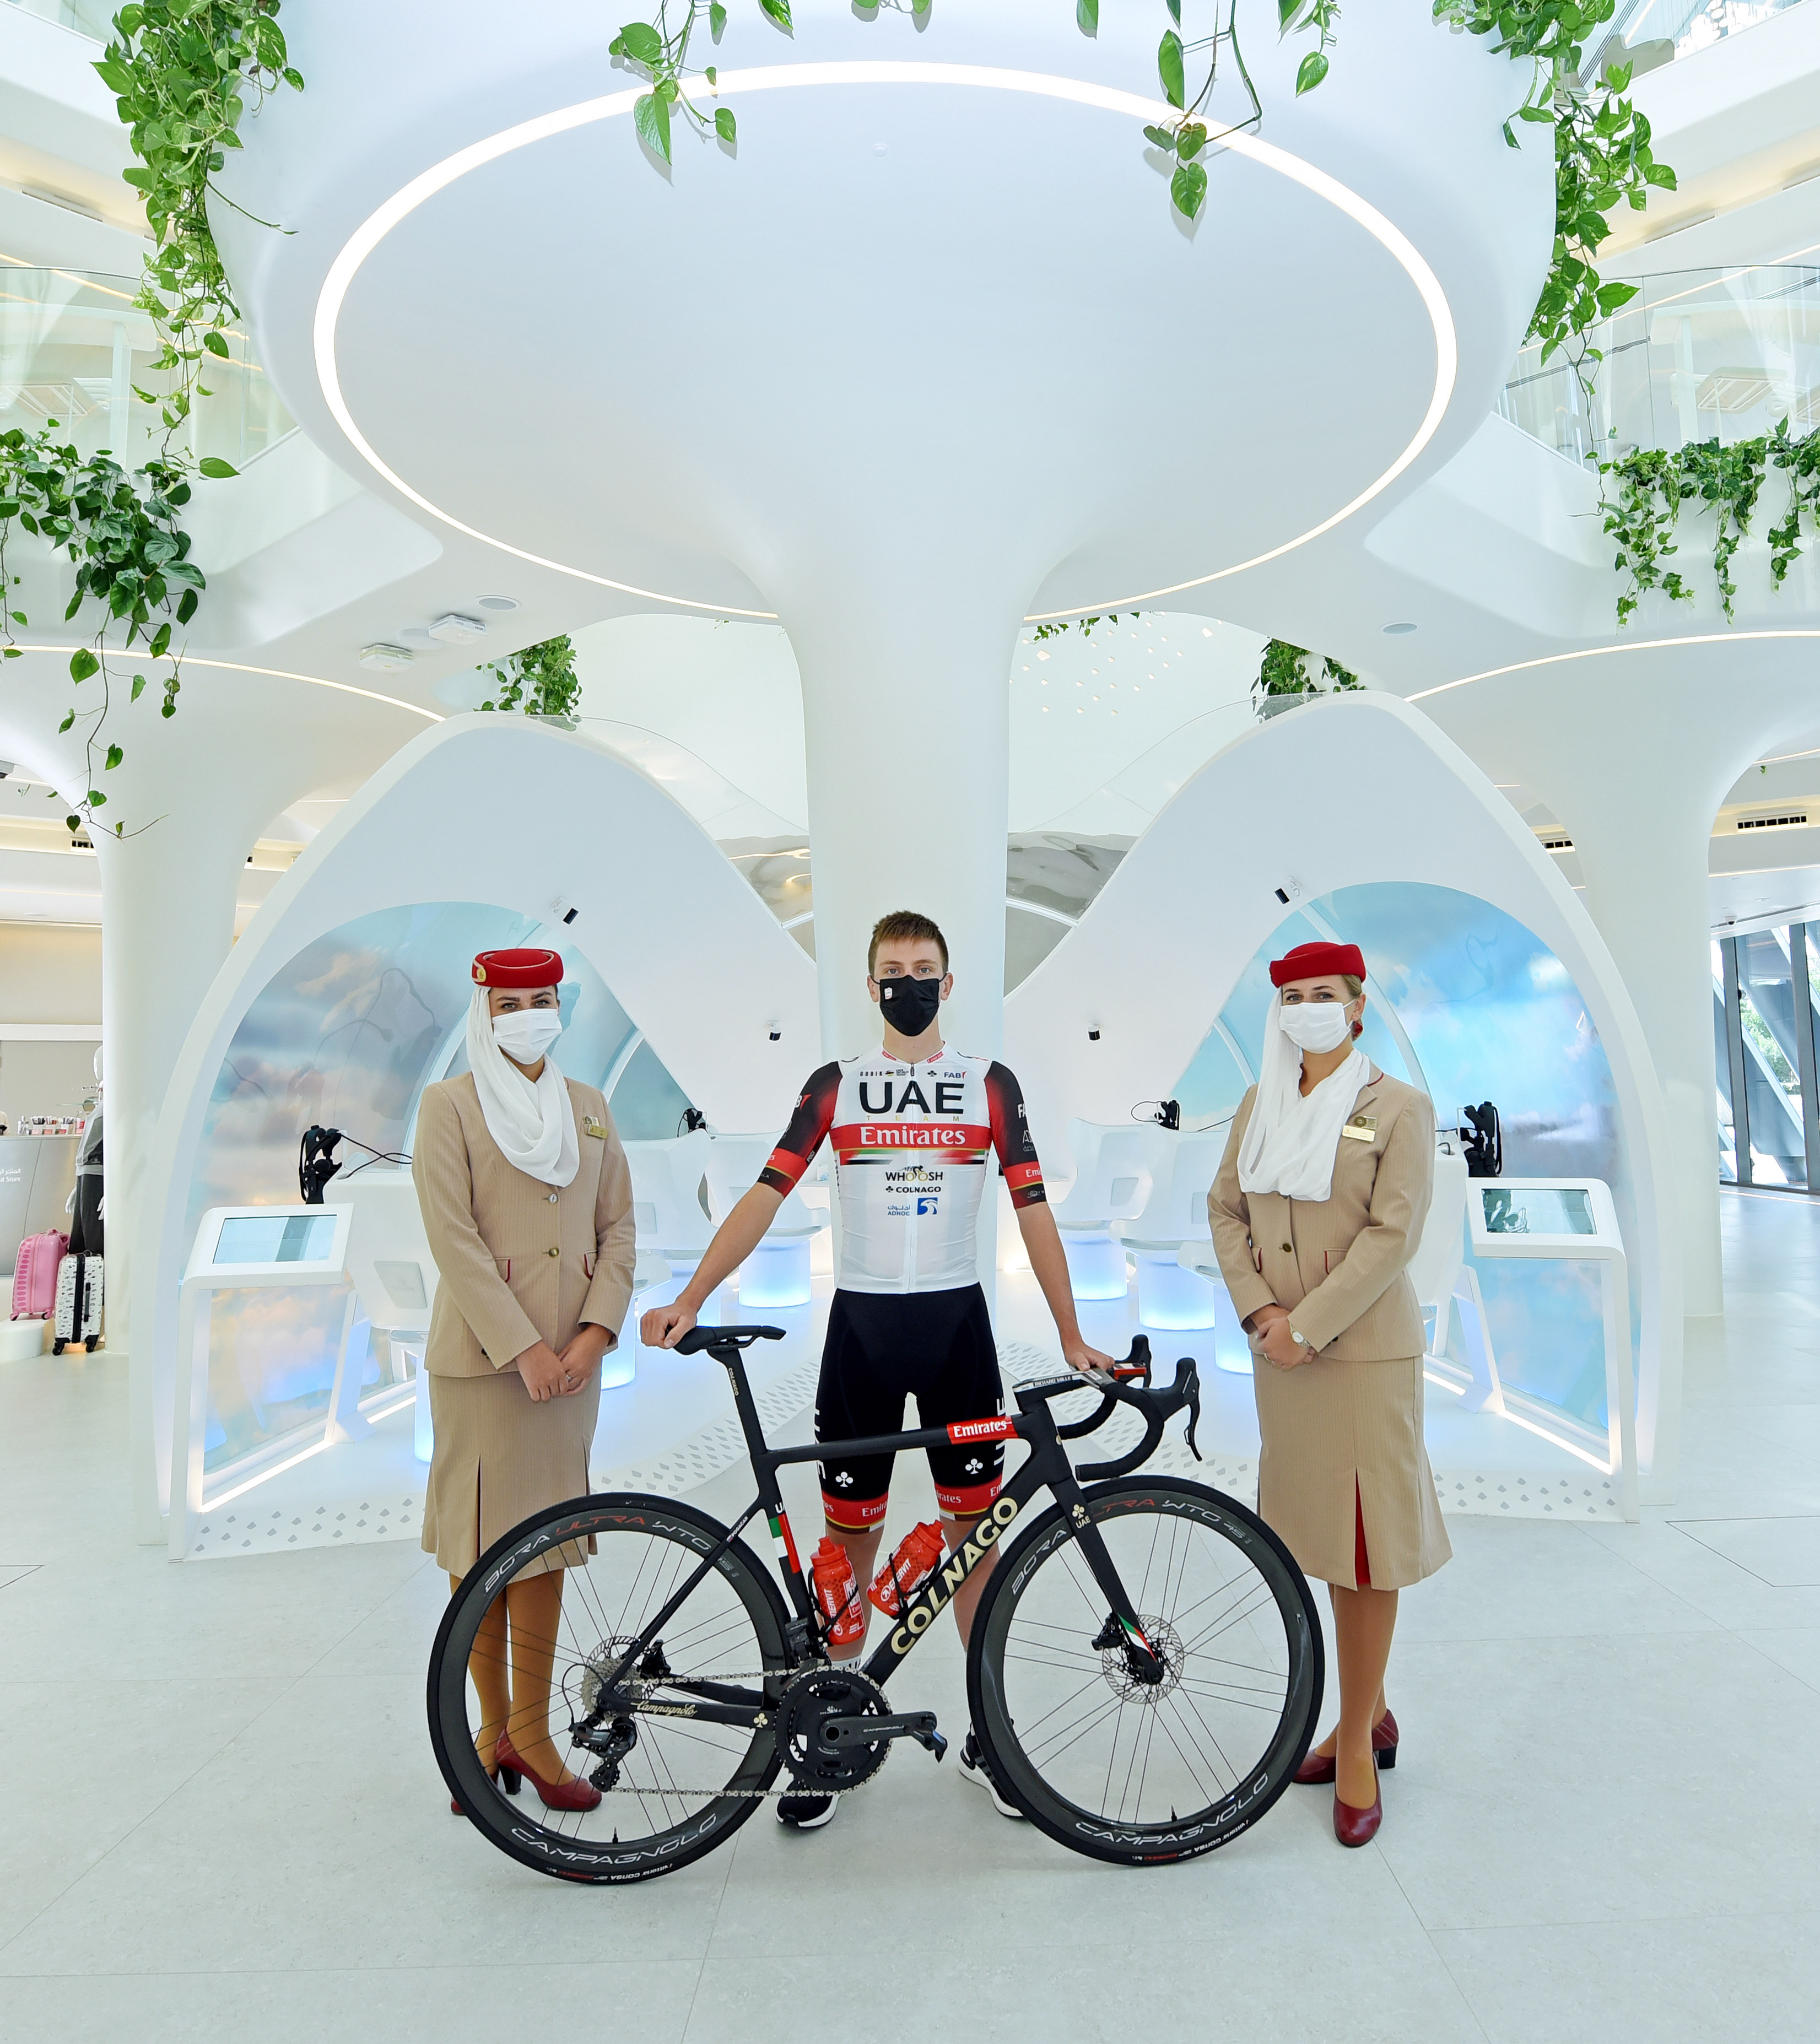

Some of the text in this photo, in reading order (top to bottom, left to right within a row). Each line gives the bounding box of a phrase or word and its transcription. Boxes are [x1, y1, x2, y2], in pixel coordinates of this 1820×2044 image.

[860, 1080, 964, 1114] UAE
[860, 1126, 965, 1145] Emirates
[885, 1172, 943, 1181] WHOOSH
[728, 1367, 739, 1396] COLNAGO
[953, 1419, 1007, 1437] Emirates
[1076, 1516, 1091, 1529] UAE
[1162, 1500, 1222, 1522] WTO
[484, 1534, 550, 1594] BORA
[556, 1516, 645, 1536] ULTRA
[652, 1521, 711, 1551] WTO
[1011, 1529, 1067, 1596] BORA
[889, 1558, 911, 1591] EERVIT
[891, 1497, 1018, 1654] COLNAGO
[630, 1700, 698, 1717] Campagnolo
[1076, 1772, 1268, 1846] CAMPAGNOLO
[511, 1813, 717, 1864] CAMPAGNOLO
